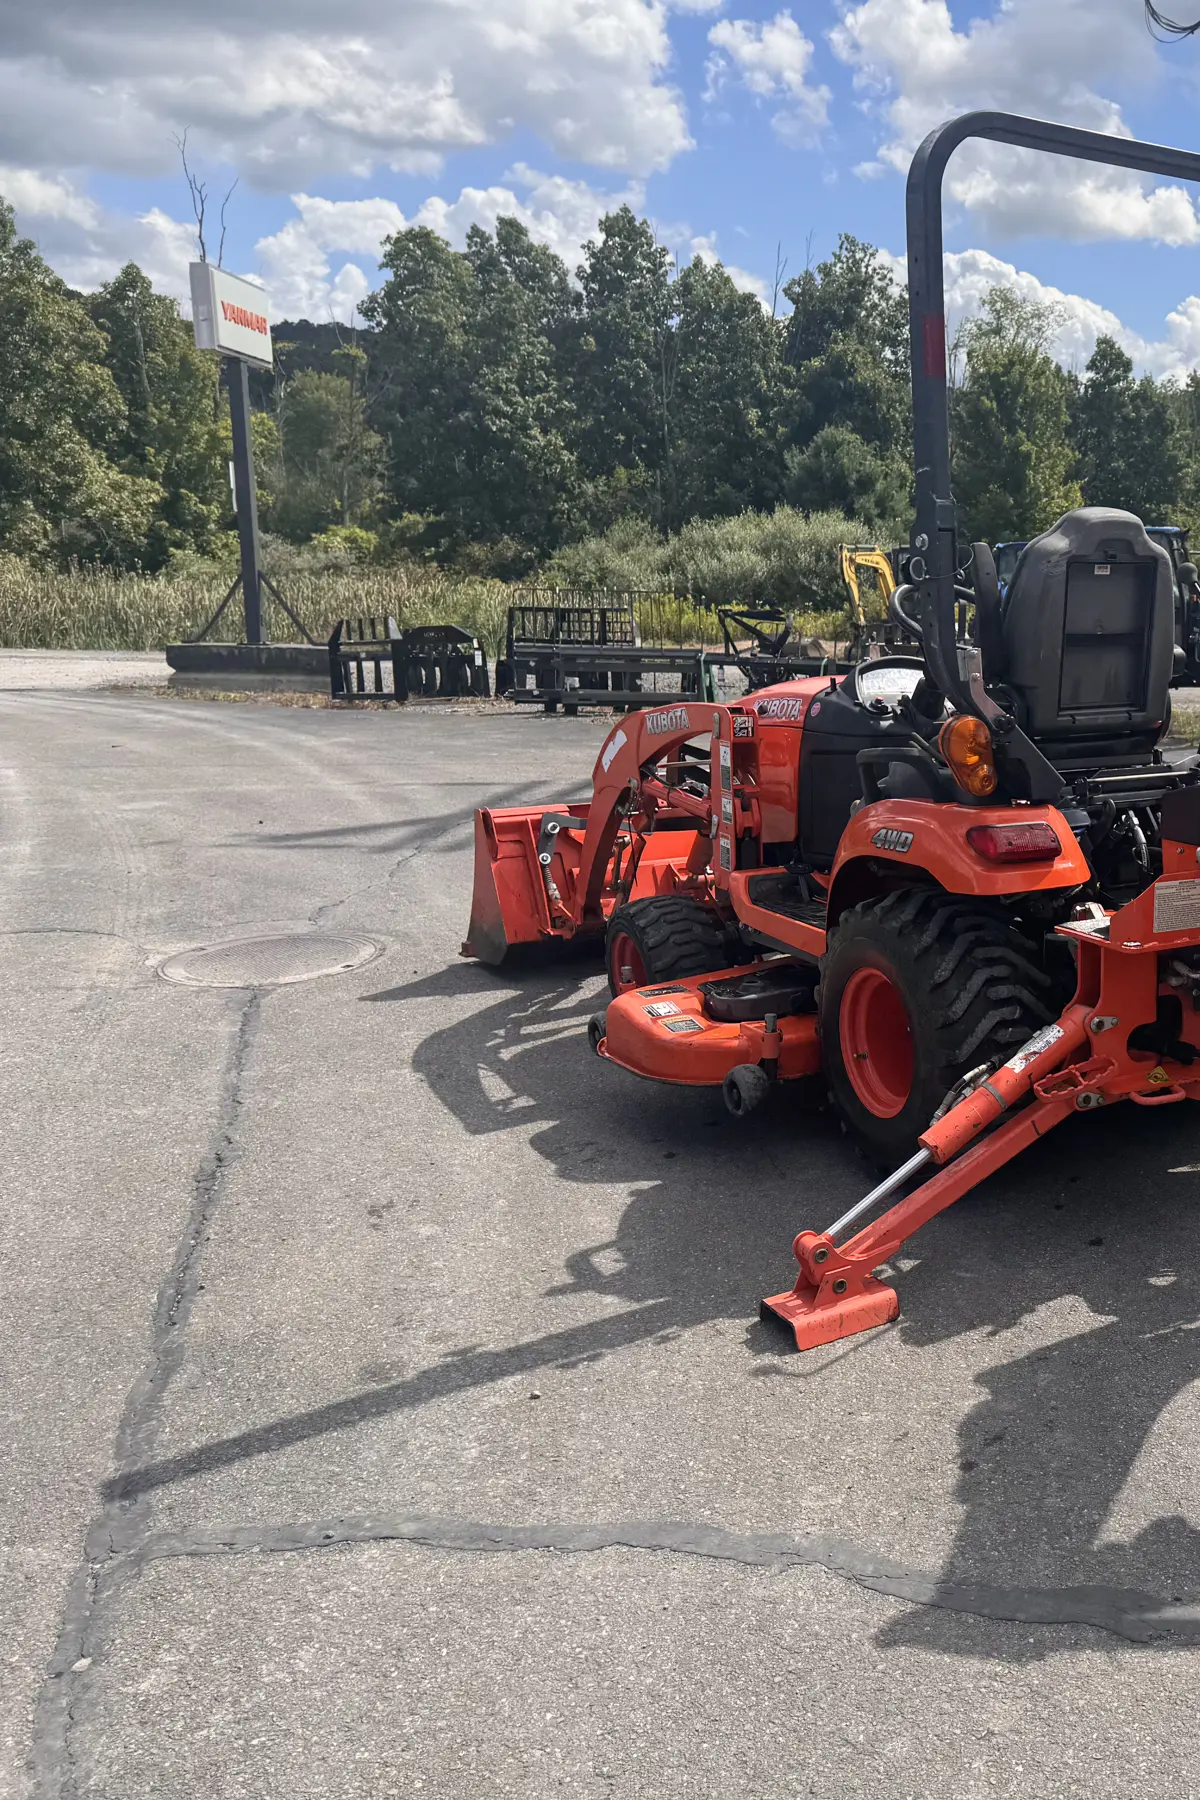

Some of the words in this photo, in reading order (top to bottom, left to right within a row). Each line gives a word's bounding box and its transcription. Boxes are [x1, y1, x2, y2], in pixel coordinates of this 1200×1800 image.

[221, 300, 267, 335] YANMAR
[646, 708, 690, 734] KUBOTA
[870, 827, 914, 853] 4WD
